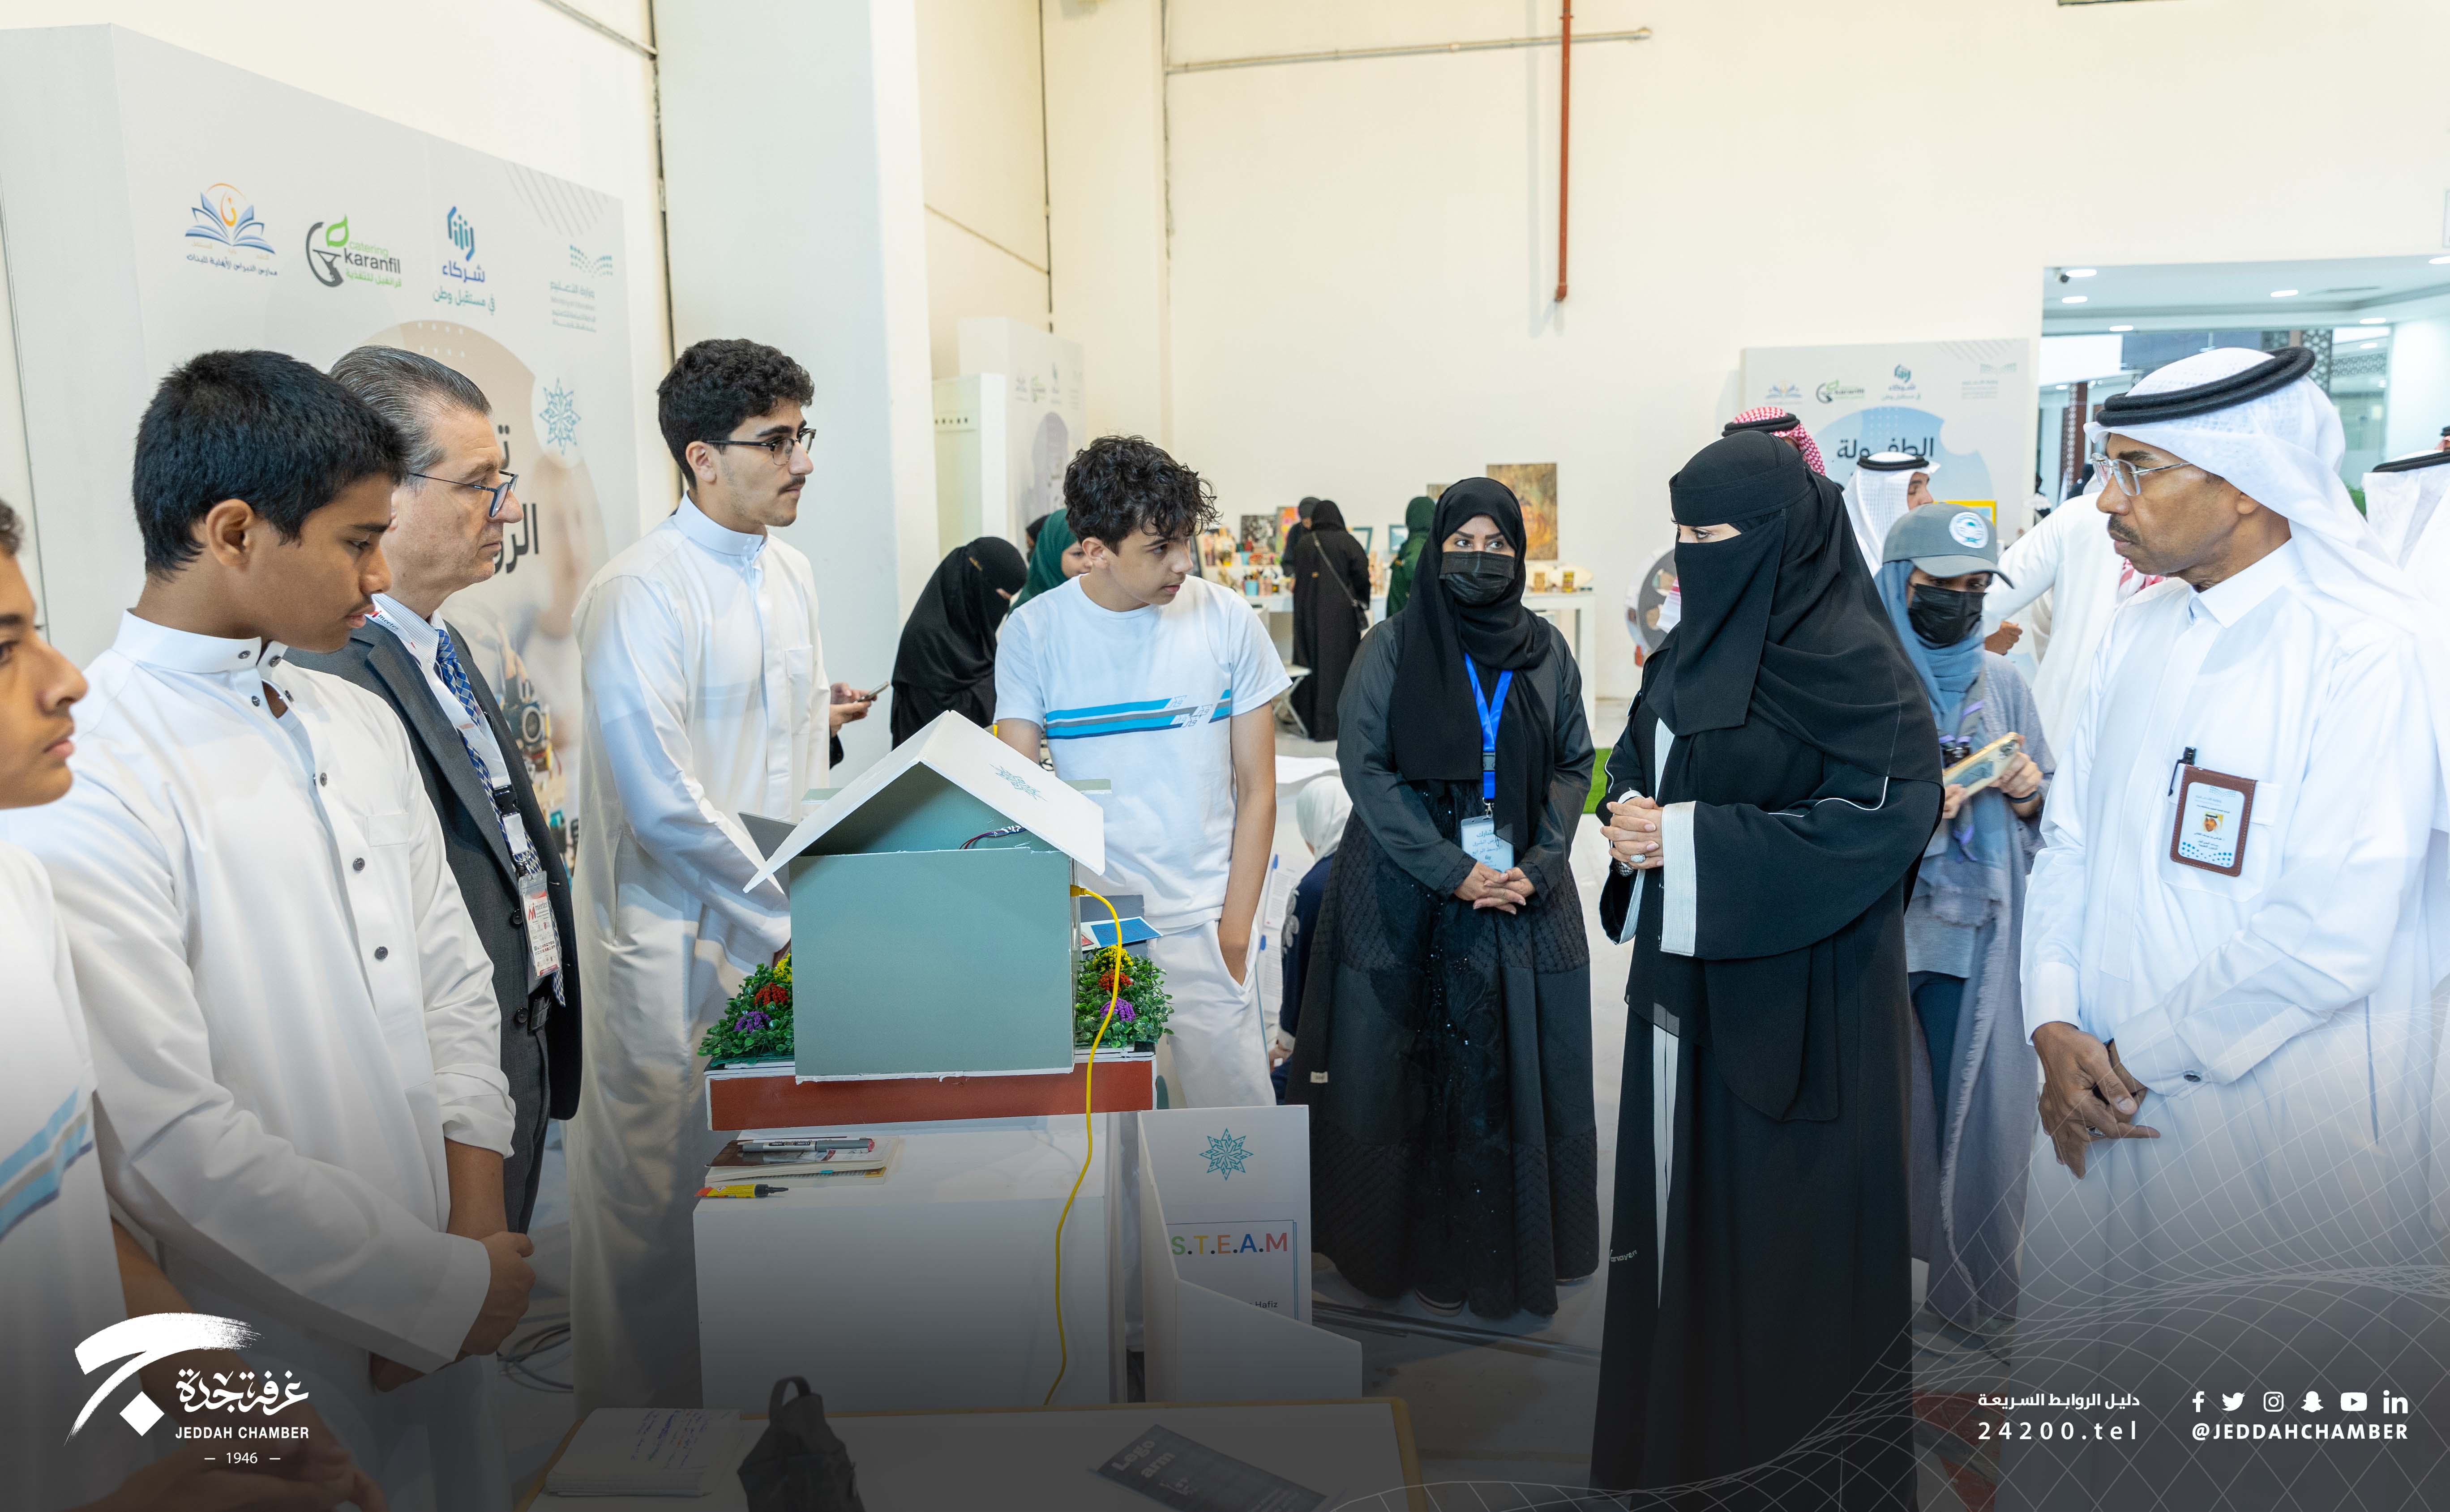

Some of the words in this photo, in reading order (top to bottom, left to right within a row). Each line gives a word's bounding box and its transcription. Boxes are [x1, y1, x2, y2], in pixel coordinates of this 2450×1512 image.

[344, 248, 401, 274] karanfil
[349, 241, 389, 258] catering
[441, 260, 485, 283] شركاء
[433, 285, 453, 305] وطن
[455, 289, 486, 307] مستقبل
[1170, 1232, 1288, 1255] S.T.E.A.M
[1111, 1439, 1156, 1471] Lego
[1141, 1452, 1175, 1478] arm
